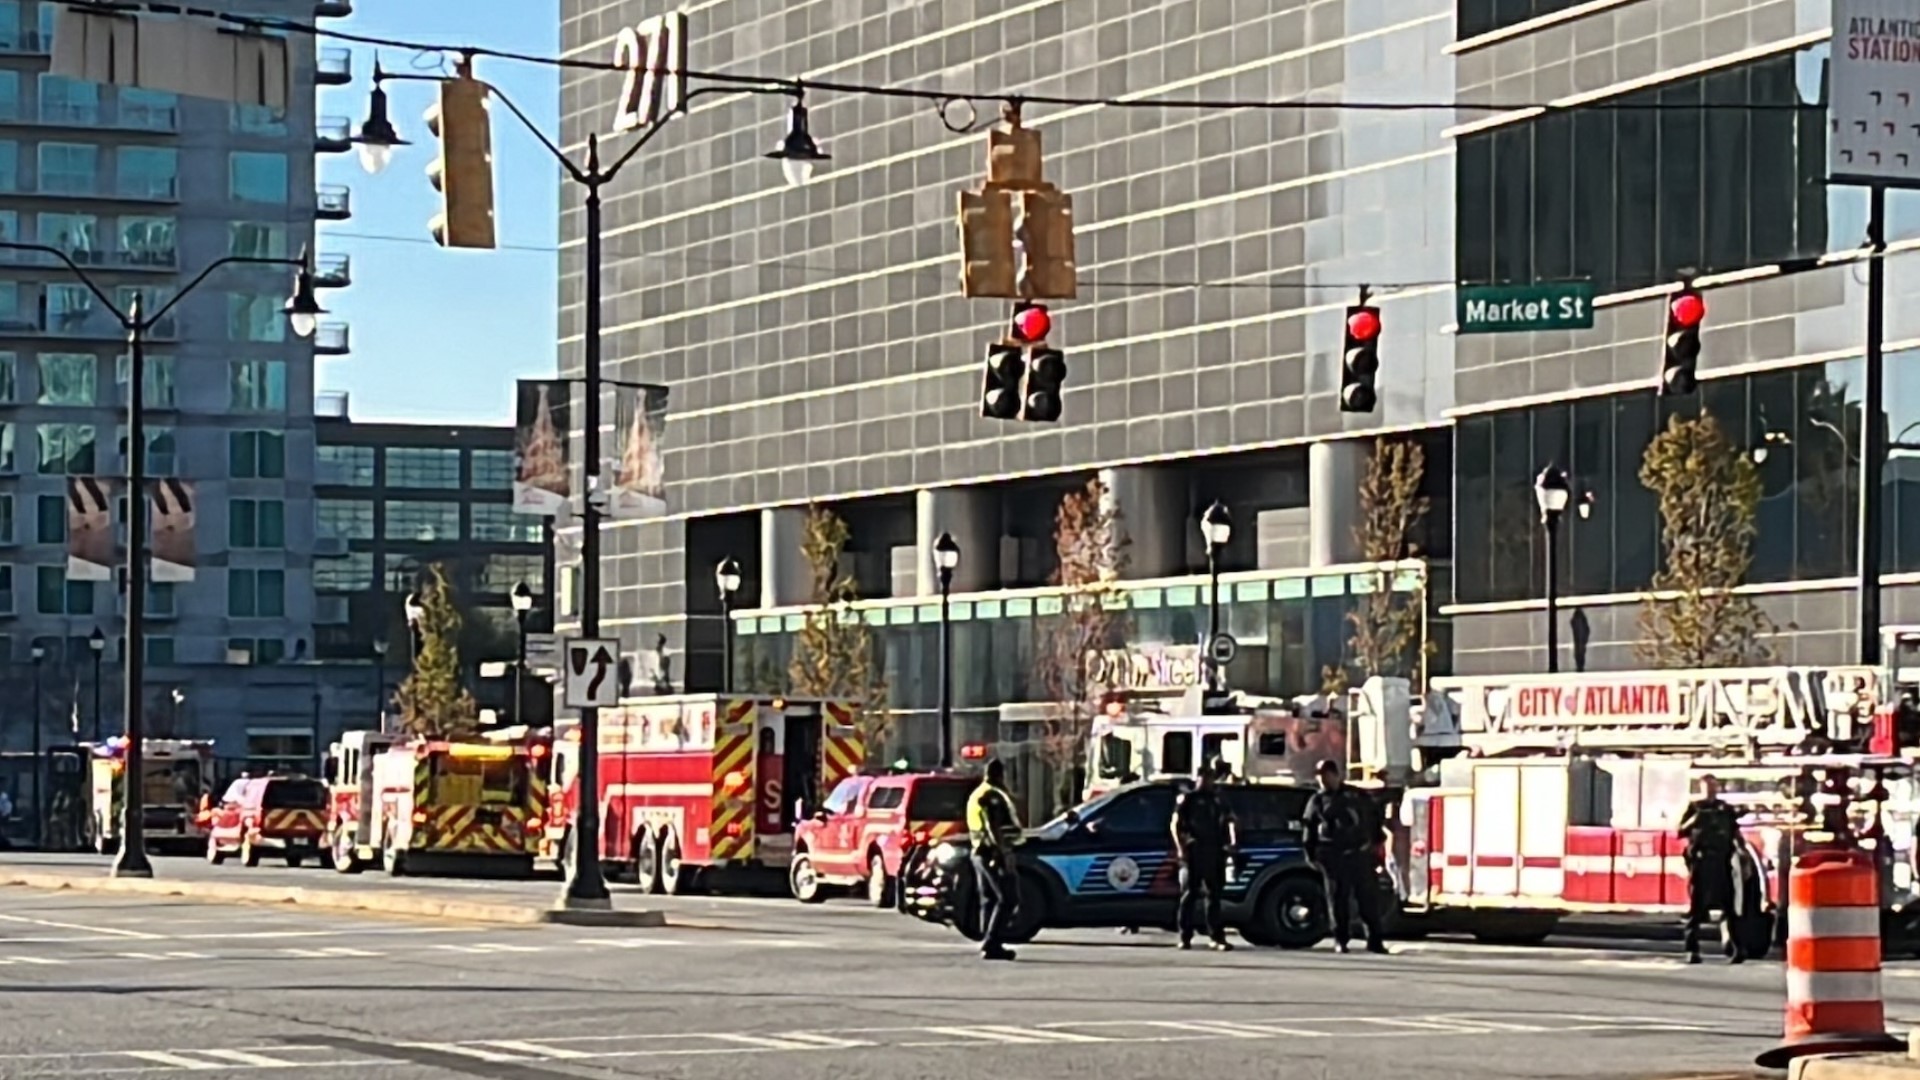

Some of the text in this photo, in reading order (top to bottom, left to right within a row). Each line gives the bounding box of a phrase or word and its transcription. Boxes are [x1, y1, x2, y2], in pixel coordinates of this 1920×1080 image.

[1848, 37, 1920, 63] STATION
[612, 10, 683, 132] 271
[1466, 296, 1584, 322] Market St
[1519, 687, 1562, 717] CITY
[1584, 685, 1670, 716] ATLANTA
